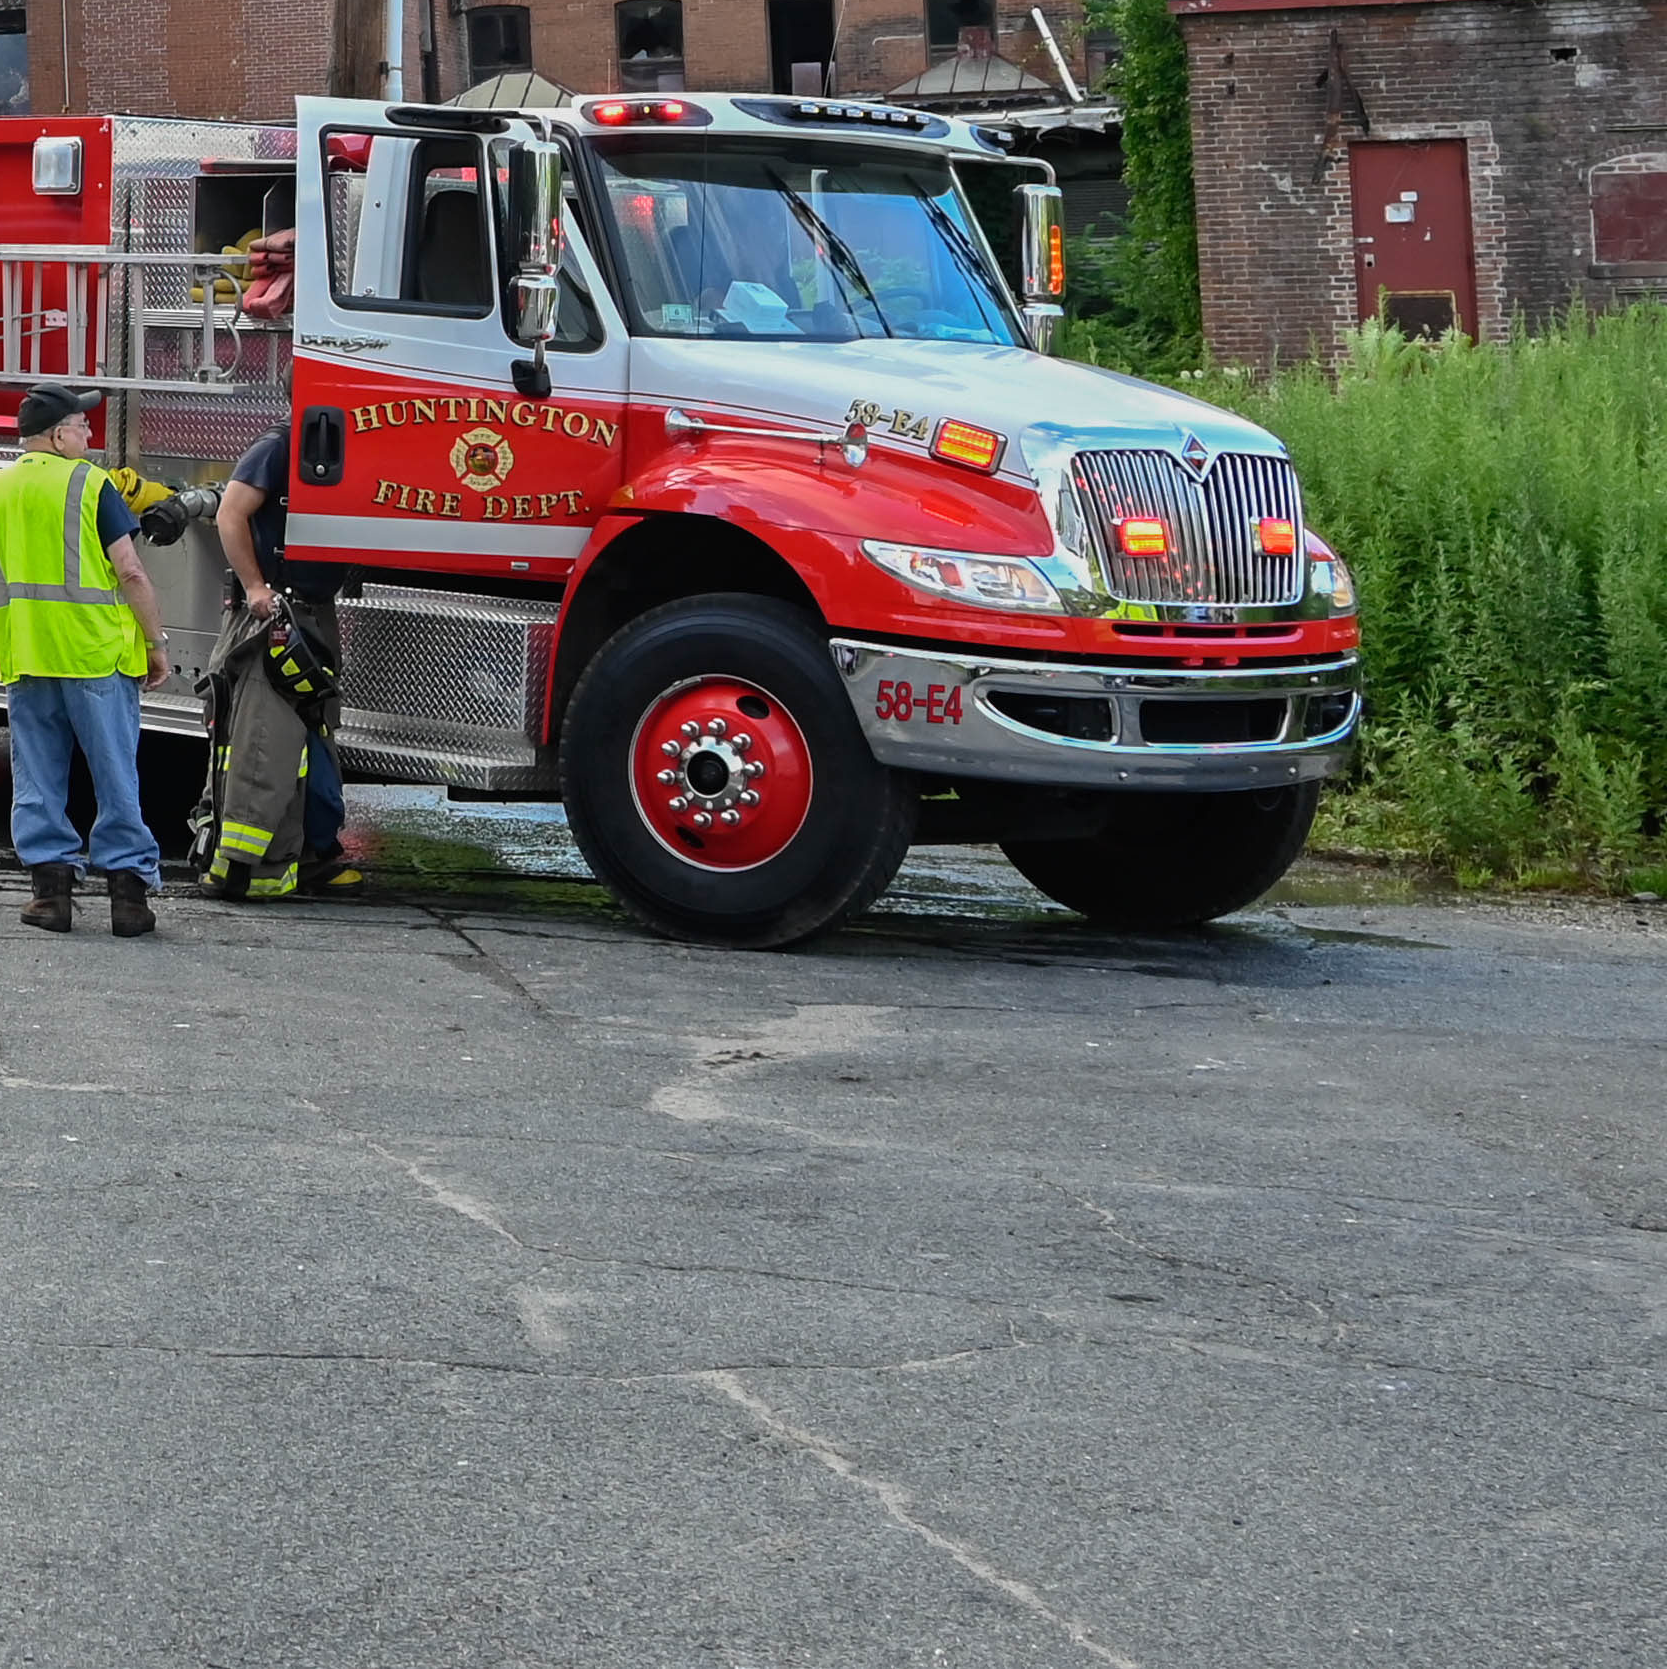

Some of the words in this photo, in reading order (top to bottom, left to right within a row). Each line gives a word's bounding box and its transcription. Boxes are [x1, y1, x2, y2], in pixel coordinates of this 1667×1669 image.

[351, 397, 619, 448] HUNTINGTON
[844, 398, 930, 441] 58-E4
[372, 479, 463, 518] FIRE
[483, 490, 592, 520] DEPT.
[875, 679, 964, 725] 58-E4
